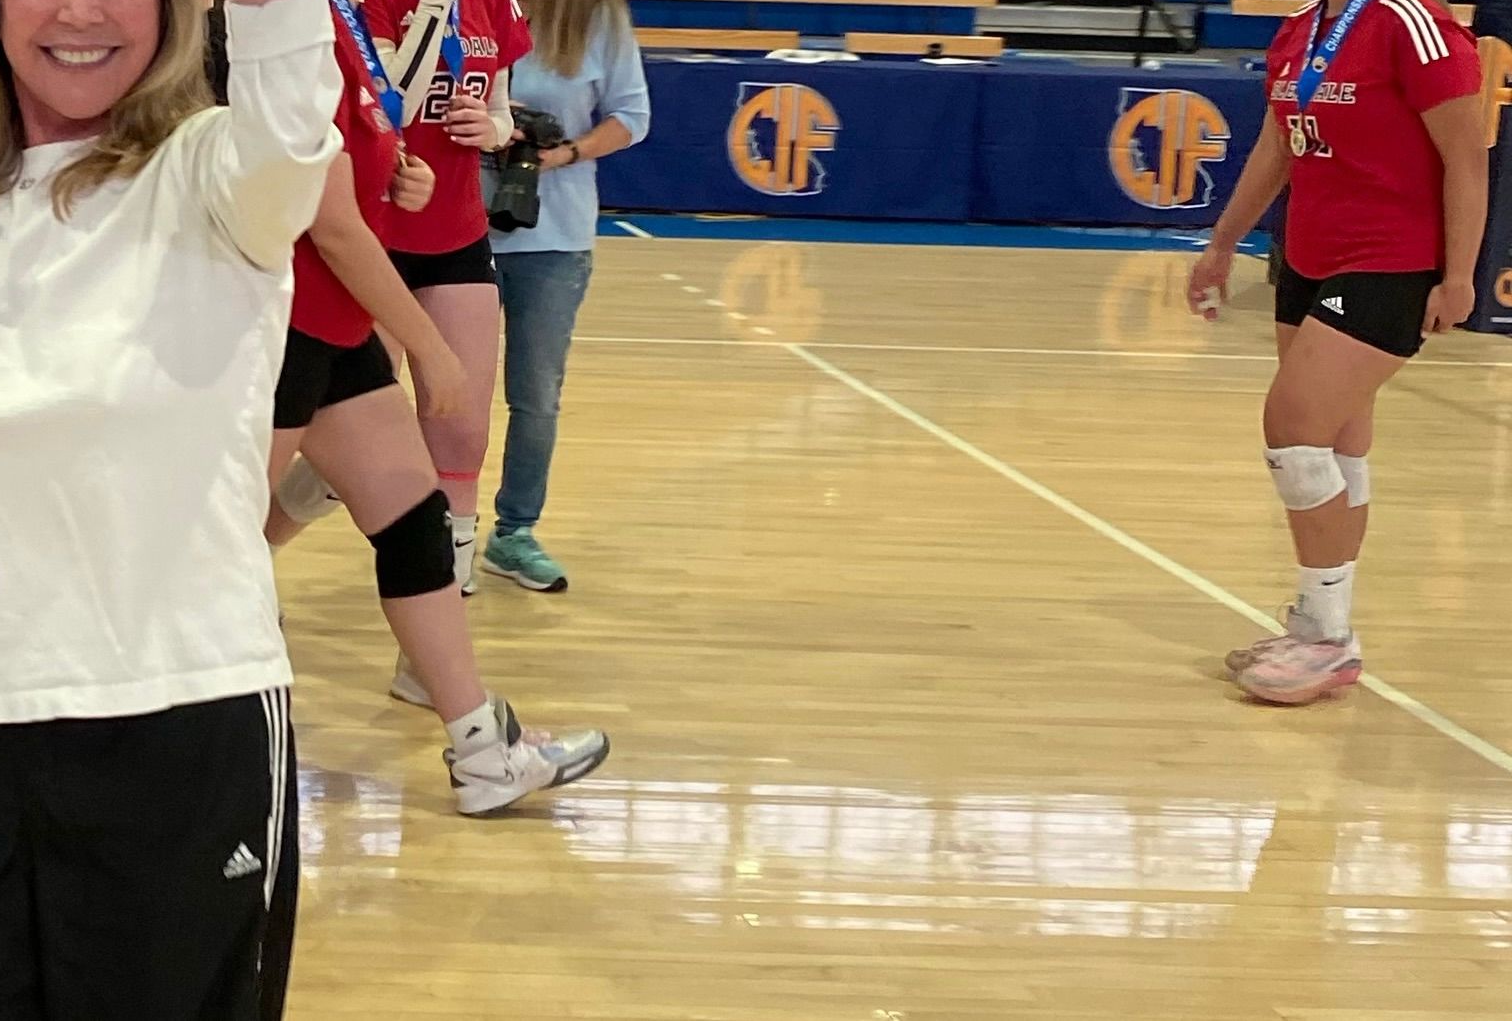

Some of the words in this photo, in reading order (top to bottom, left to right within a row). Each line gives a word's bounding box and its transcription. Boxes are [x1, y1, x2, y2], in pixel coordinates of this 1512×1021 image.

[420, 71, 490, 124] 23
[727, 82, 841, 195] CIF
[1108, 89, 1231, 209] CIF
